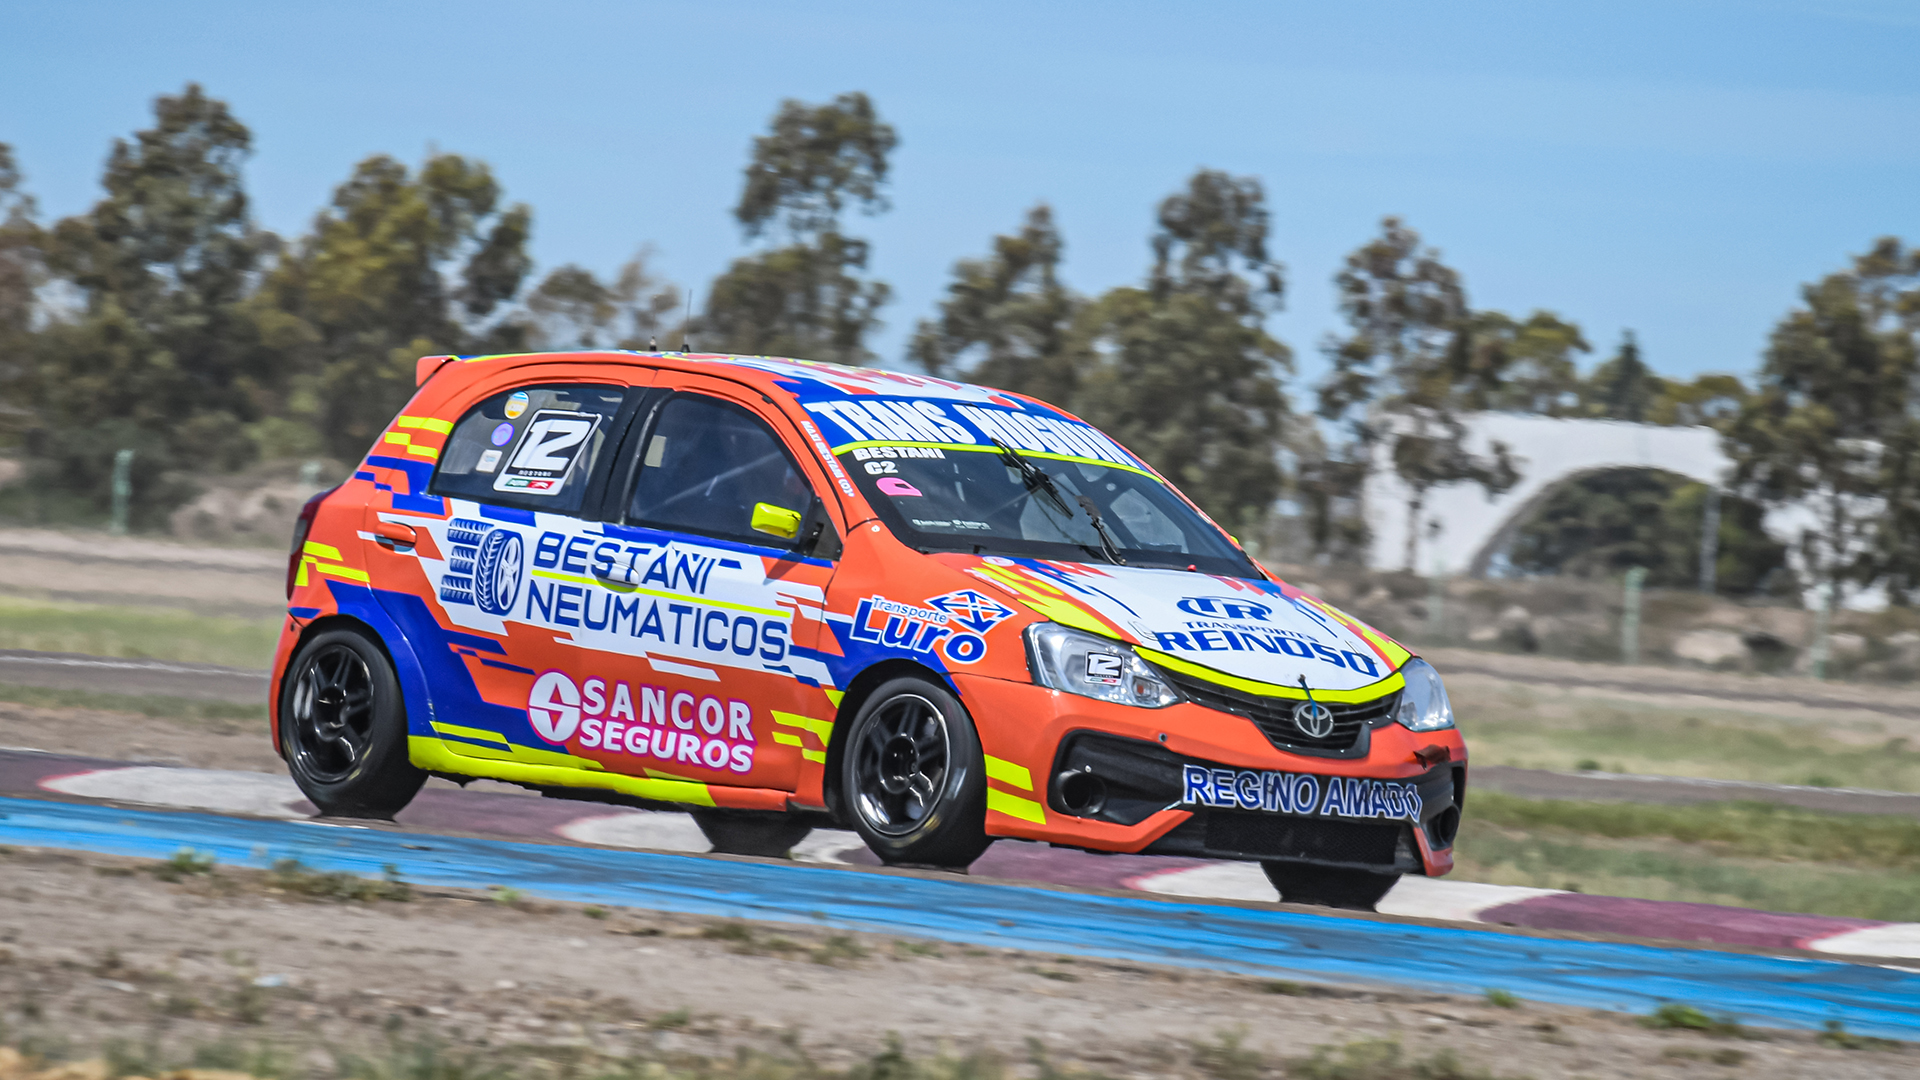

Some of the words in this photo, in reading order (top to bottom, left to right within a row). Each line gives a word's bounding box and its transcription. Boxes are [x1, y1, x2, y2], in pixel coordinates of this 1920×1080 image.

[511, 419, 592, 471] 12
[802, 400, 977, 445] TRANS
[852, 446, 946, 461] BESTANI
[863, 460, 899, 475] C2
[533, 531, 716, 594] BESTANI
[526, 579, 788, 662] NEUMATICOS
[850, 599, 987, 663] Luro
[872, 596, 948, 624] Transporte
[1088, 654, 1121, 676] 12
[1155, 629, 1379, 678] REINOSO
[582, 678, 754, 742] SANCOR
[579, 718, 753, 773] SEGUROS
[1183, 764, 1320, 815] REGINO
[1320, 777, 1423, 823] AMADO
